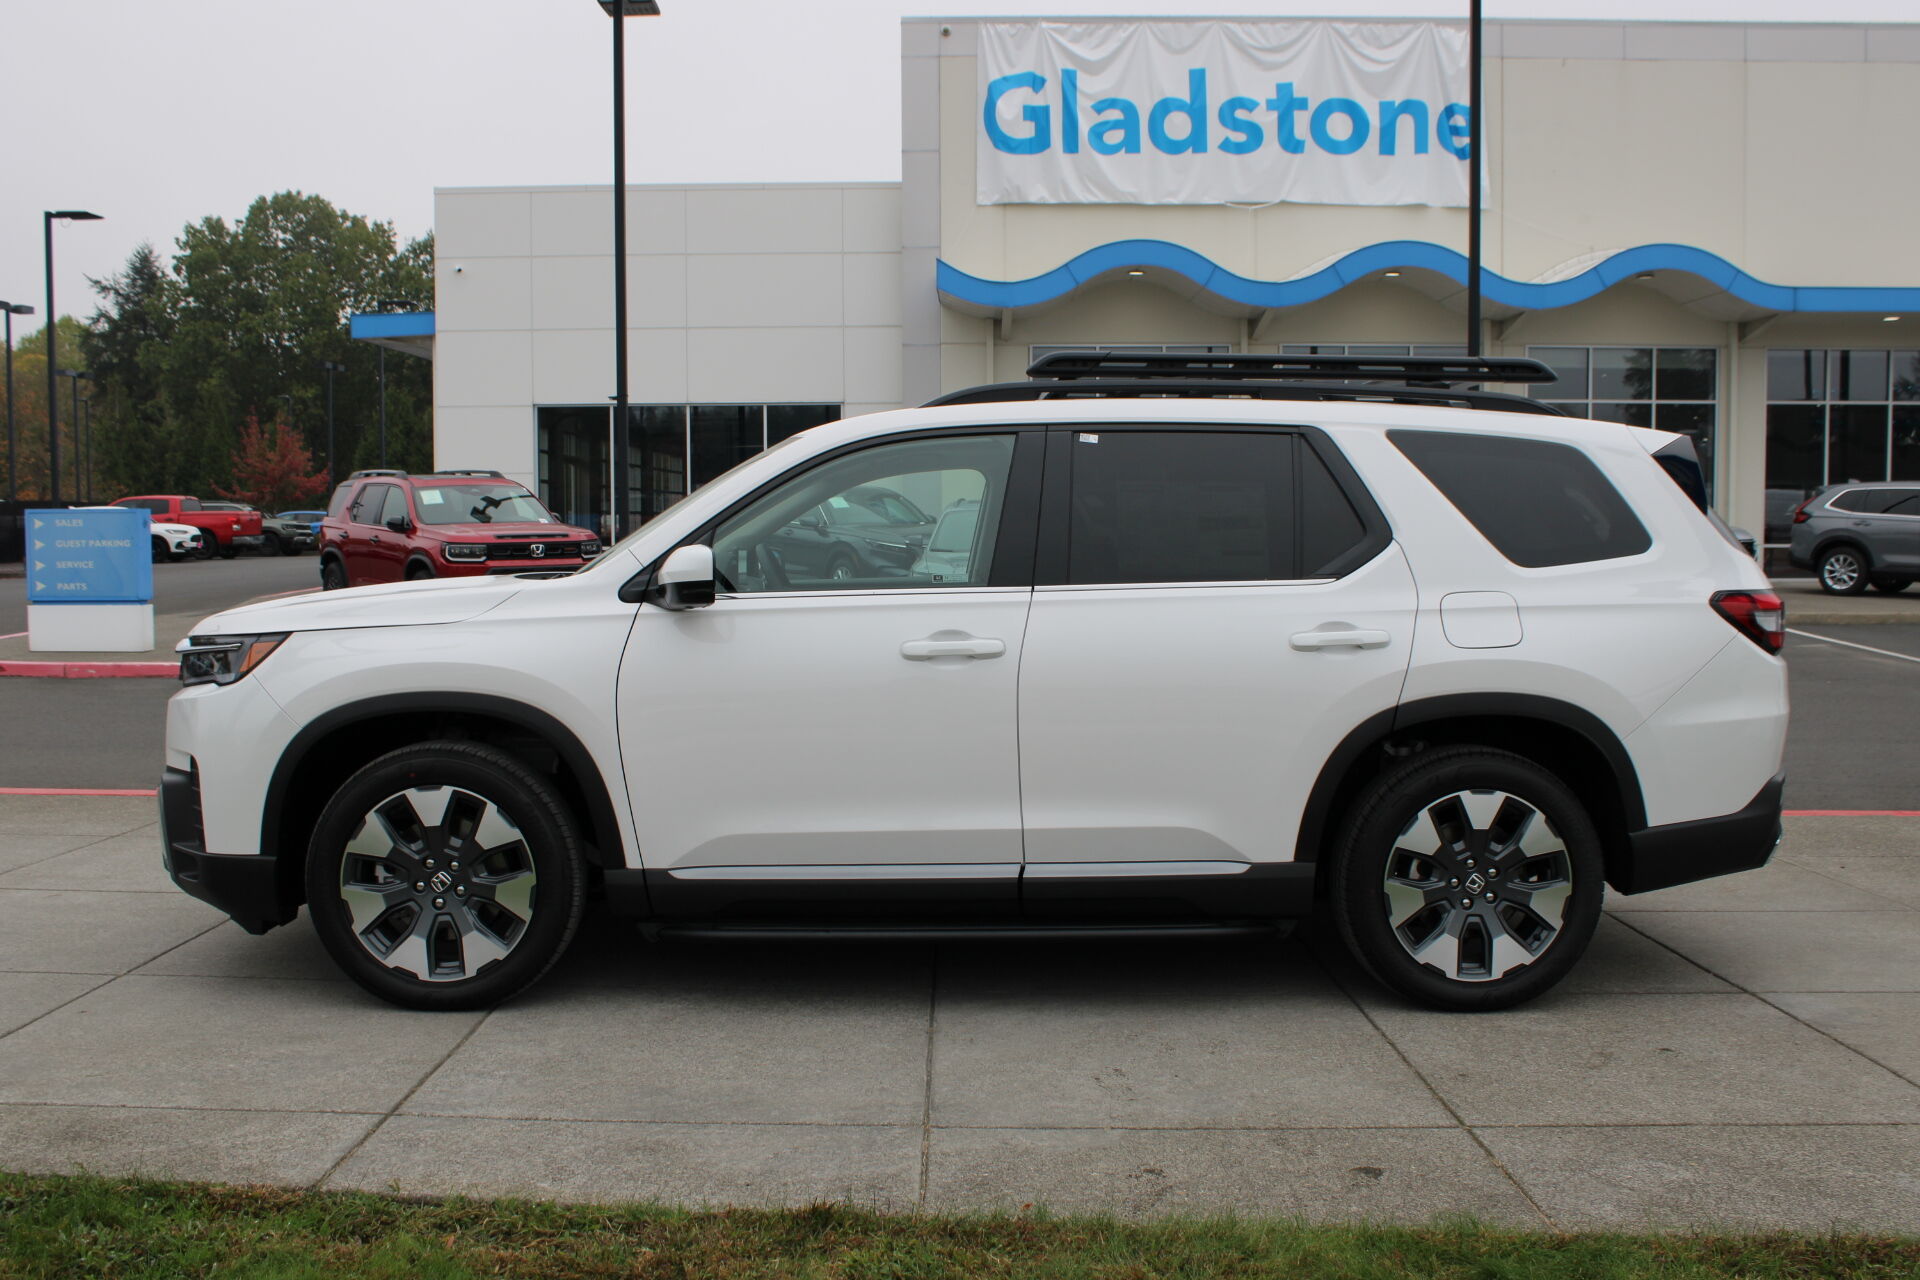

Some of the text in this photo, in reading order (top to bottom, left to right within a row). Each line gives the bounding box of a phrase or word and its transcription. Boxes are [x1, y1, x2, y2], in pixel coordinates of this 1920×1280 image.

[983, 67, 1471, 160] Gladstone
[55, 518, 83, 527] SALES
[55, 539, 131, 548] GUEST PARKING
[55, 560, 95, 569] SERVICE
[56, 582, 87, 591] PARTS
